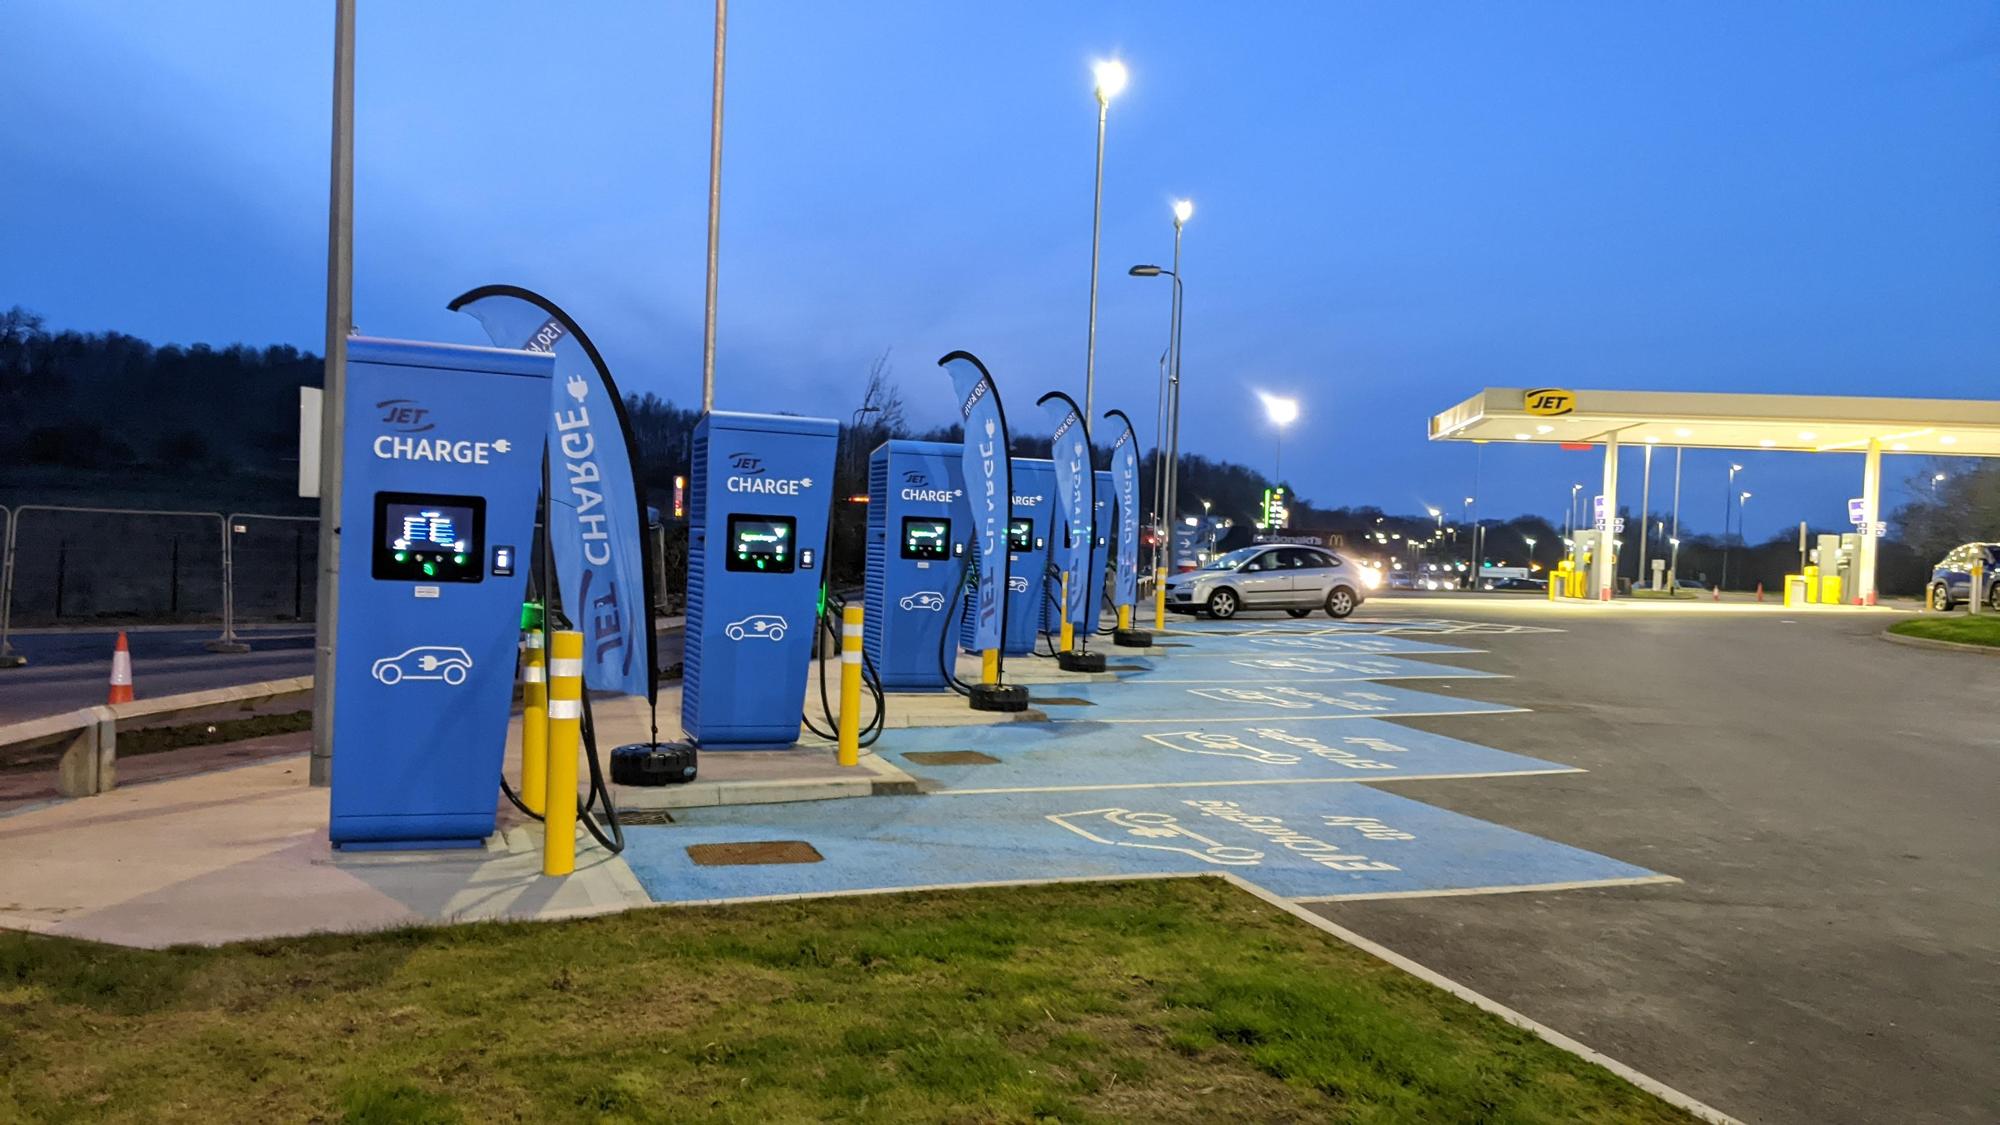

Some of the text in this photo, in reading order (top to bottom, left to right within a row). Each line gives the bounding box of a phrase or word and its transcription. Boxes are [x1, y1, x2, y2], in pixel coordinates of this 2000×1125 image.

[1531, 396, 1569, 409] JET
[382, 407, 430, 424] JET
[373, 435, 490, 464] CHARGE
[732, 457, 762, 470] JET
[727, 476, 799, 496] CHARGE
[906, 474, 927, 484] JET
[901, 488, 953, 503] CHARGE
[1011, 495, 1036, 506] ARGE
[1299, 852, 1402, 872] EV
